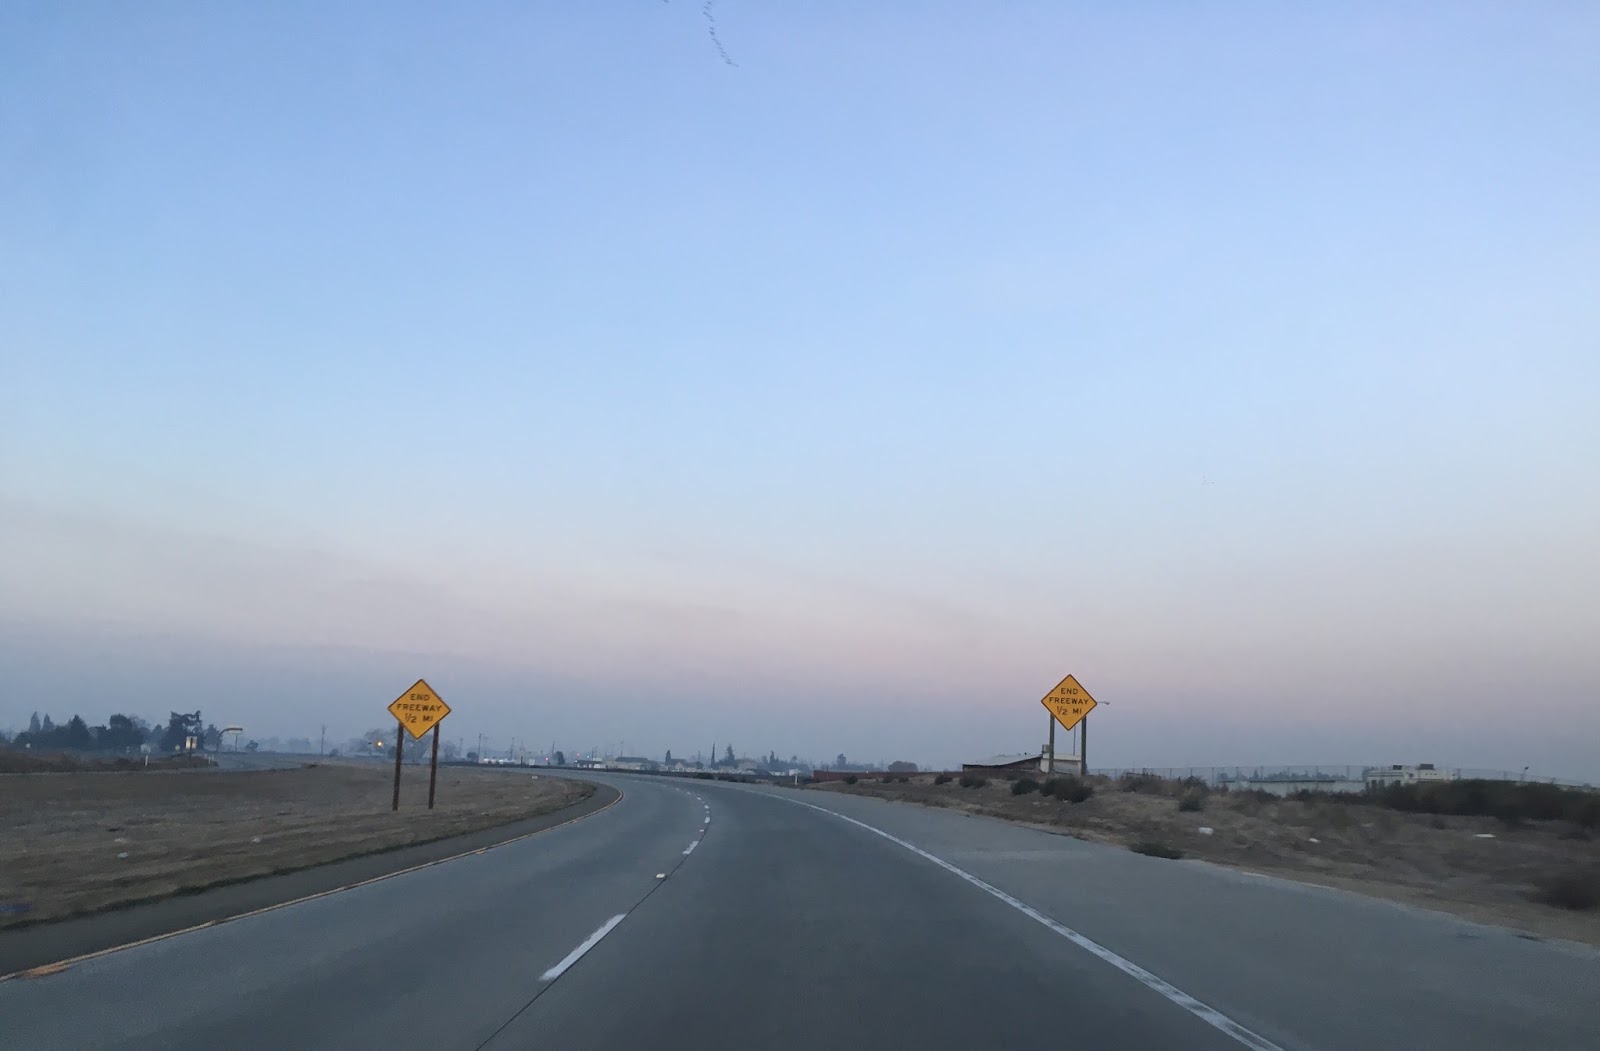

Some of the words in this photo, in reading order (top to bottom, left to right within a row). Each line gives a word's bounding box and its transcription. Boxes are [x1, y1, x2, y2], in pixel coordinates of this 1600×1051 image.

[1060, 687, 1079, 695] END
[410, 693, 430, 701] END
[1048, 696, 1090, 705] FREEWAY
[396, 703, 442, 712] FREEWAY
[1072, 707, 1082, 715] MI
